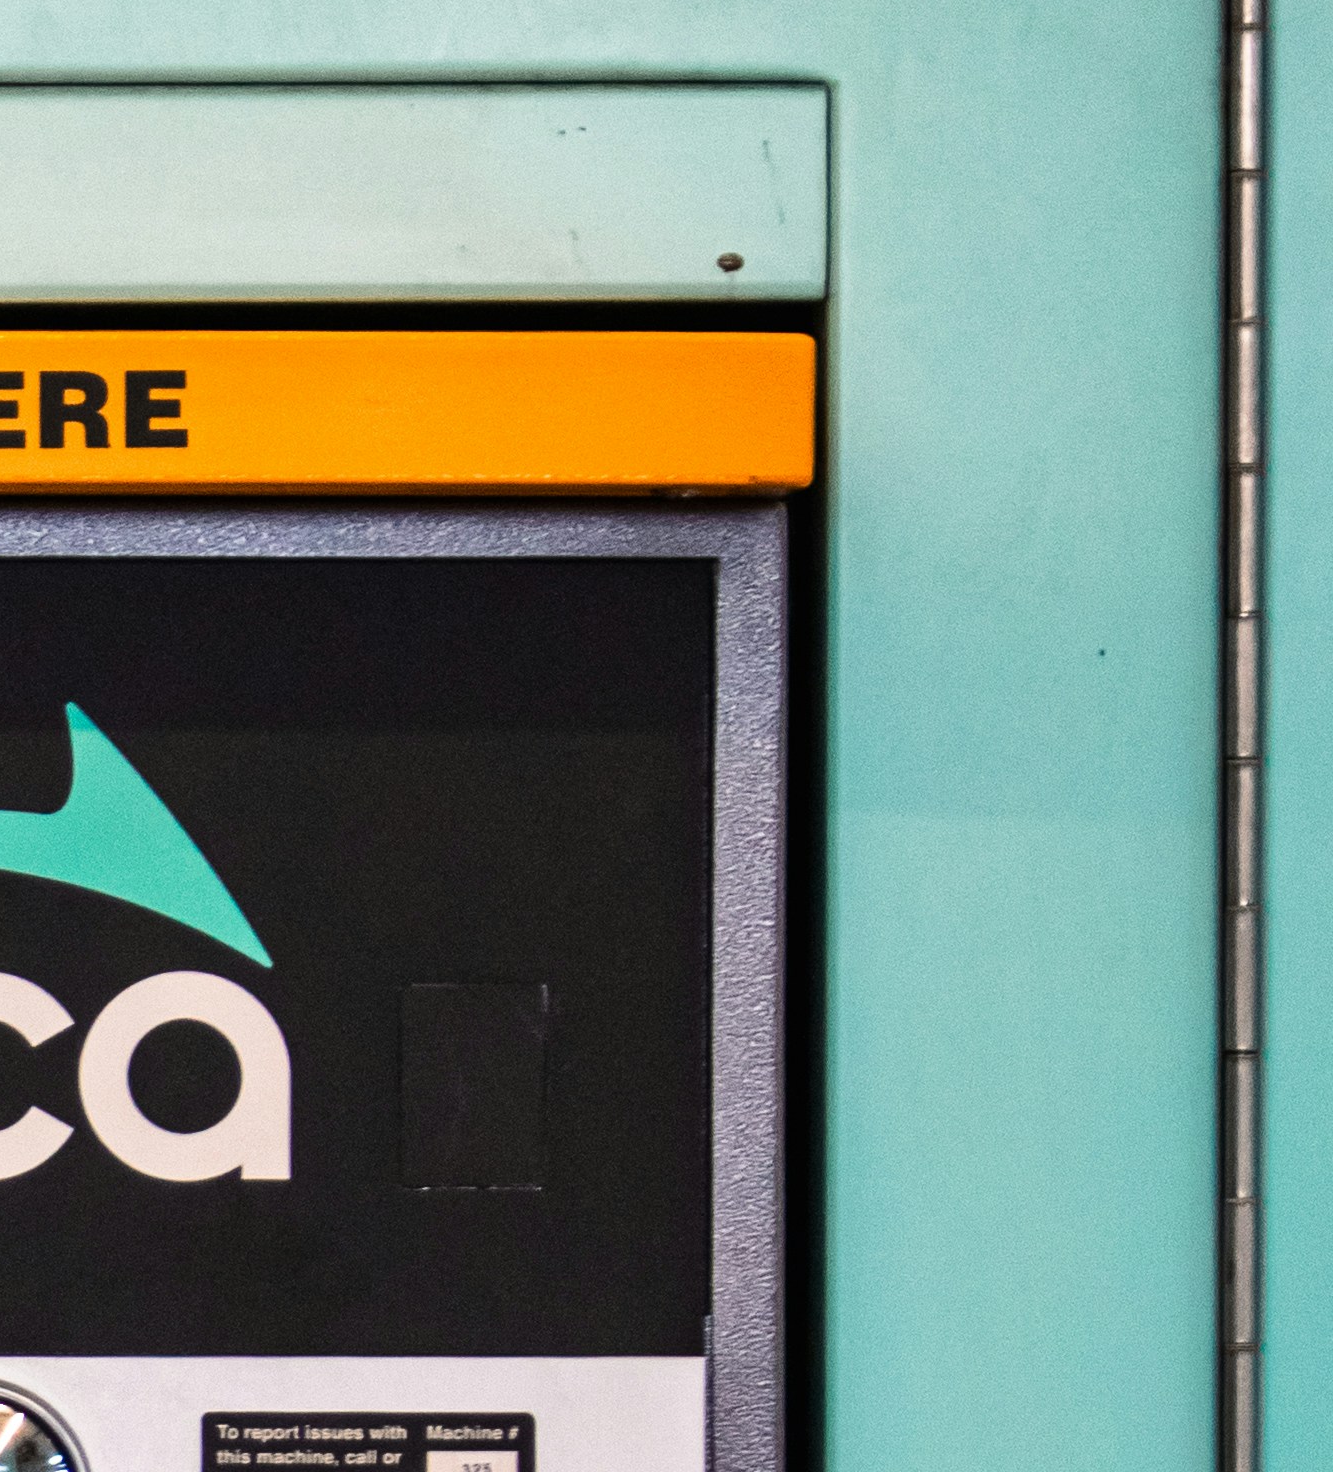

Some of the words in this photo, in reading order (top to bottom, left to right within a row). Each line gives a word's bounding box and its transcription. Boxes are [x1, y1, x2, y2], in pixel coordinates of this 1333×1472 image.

[217, 1424, 239, 1439] To
[244, 1426, 299, 1442] report
[305, 1425, 364, 1440] issues
[369, 1426, 407, 1439] with
[427, 1426, 503, 1440] Machine
[217, 1450, 251, 1464] this
[257, 1450, 339, 1465] machine,
[345, 1450, 377, 1464] call
[383, 1453, 402, 1464] or
